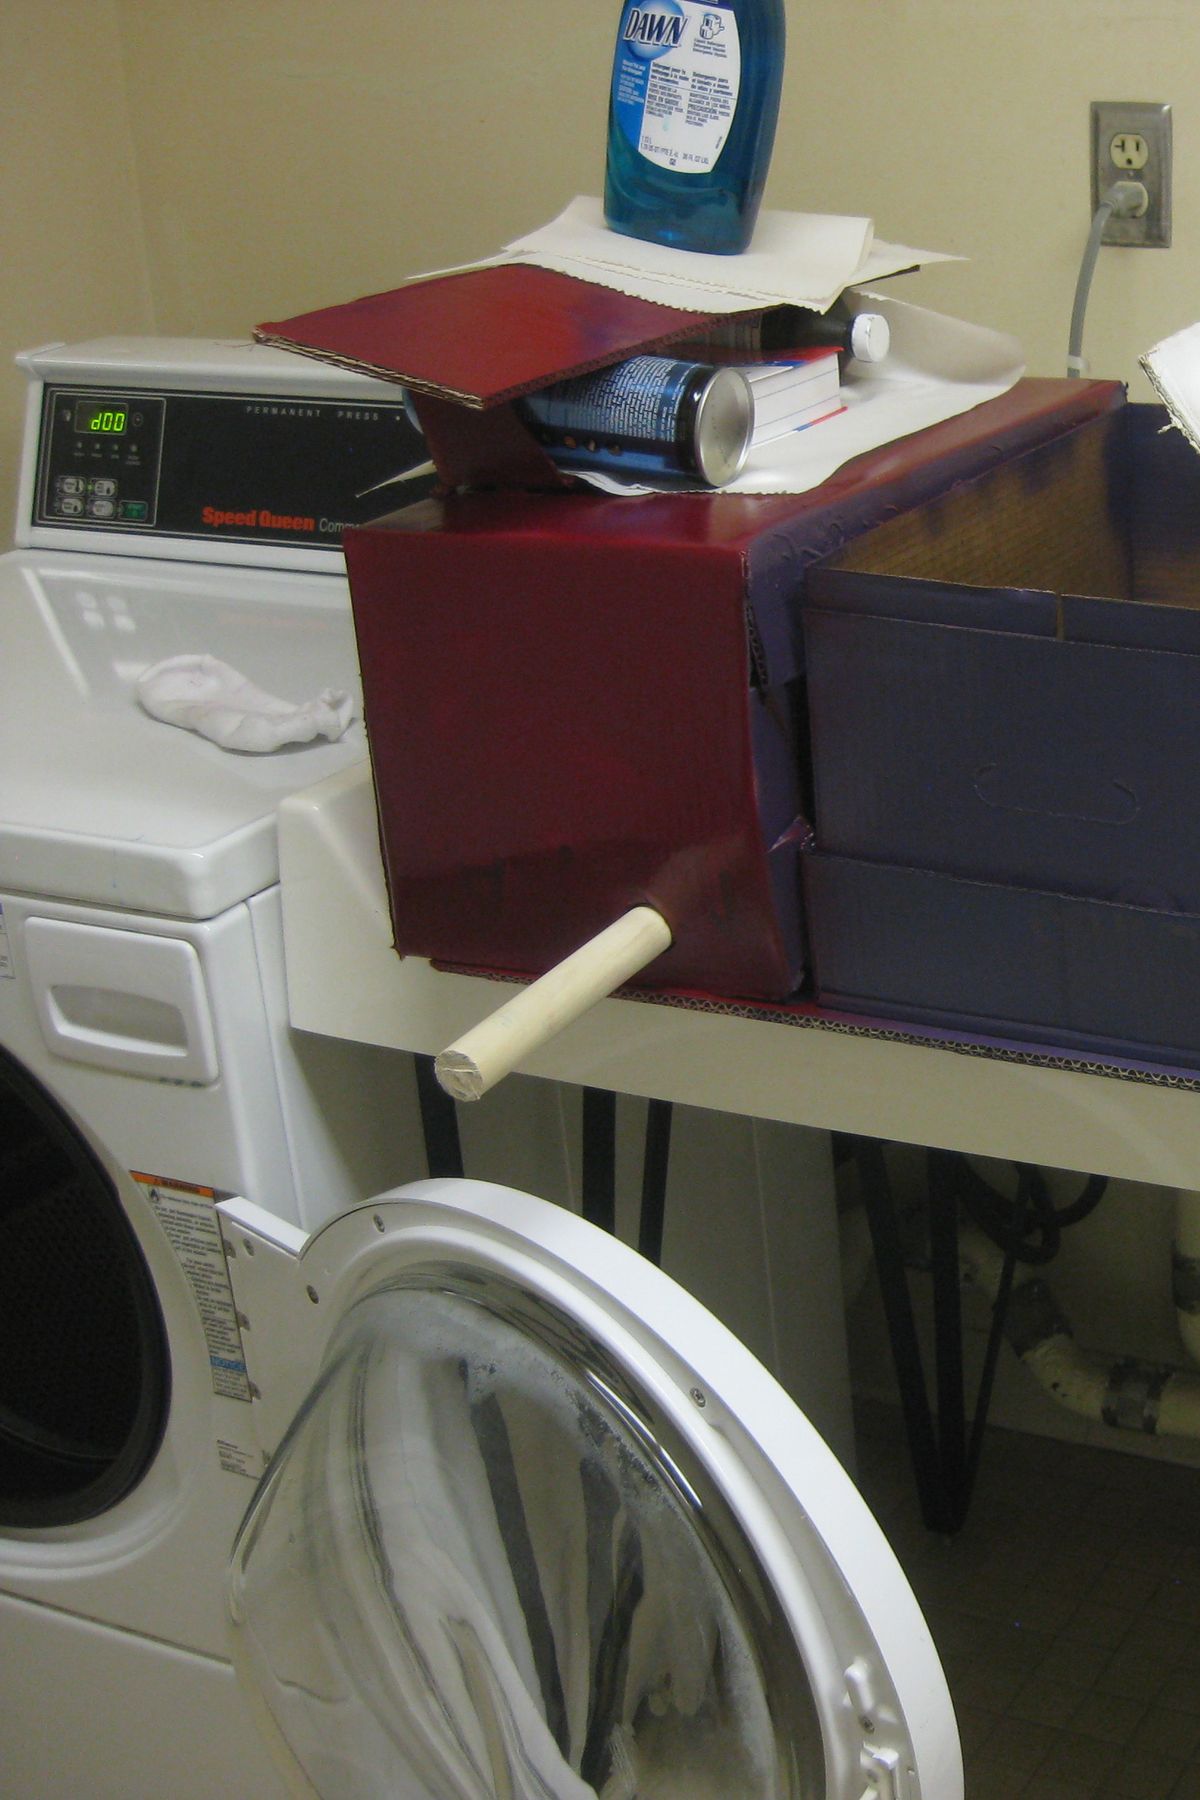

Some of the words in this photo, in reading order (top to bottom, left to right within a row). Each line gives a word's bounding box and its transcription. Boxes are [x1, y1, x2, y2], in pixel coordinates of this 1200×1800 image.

[624, 9, 688, 47] DAWN
[246, 406, 323, 419] PERMANENT
[337, 411, 380, 421] PRESS
[202, 506, 257, 528] Speed
[259, 510, 315, 532] Queen
